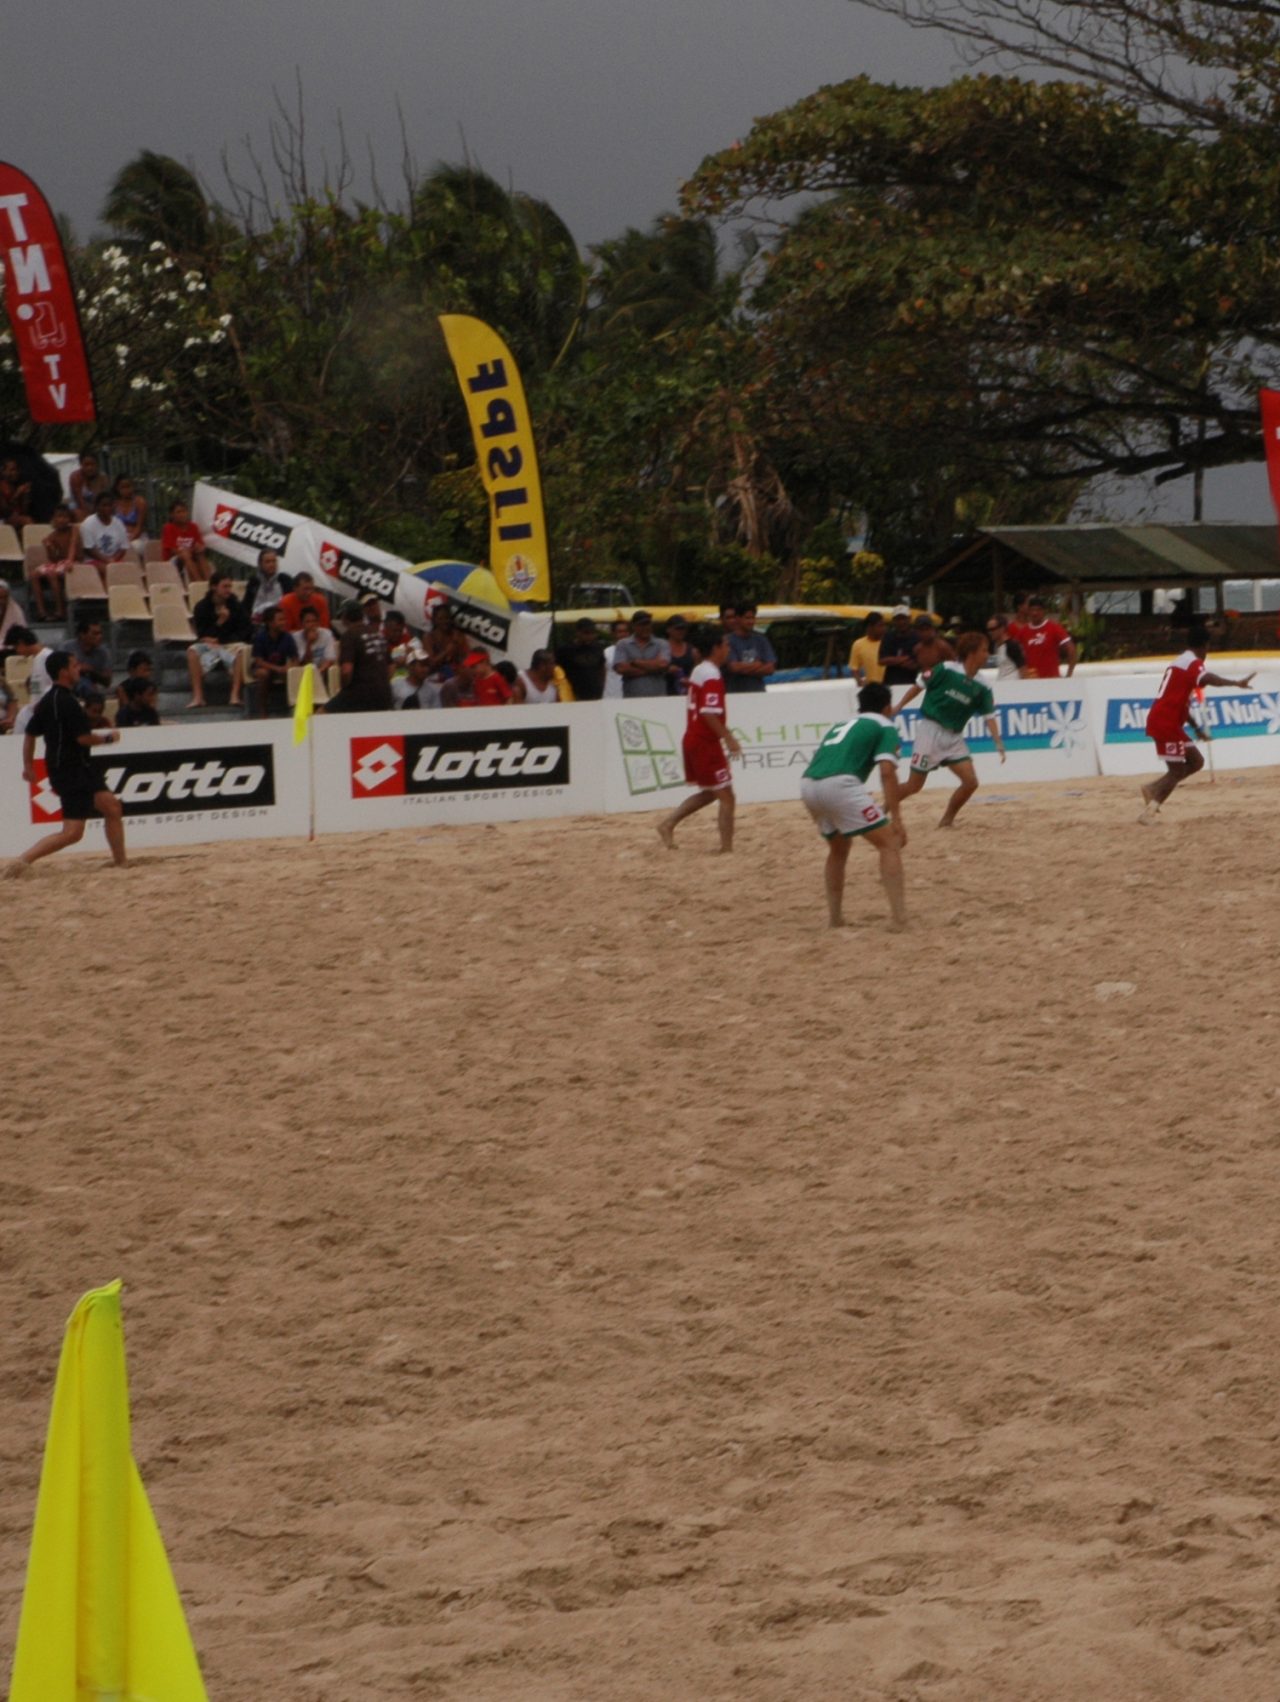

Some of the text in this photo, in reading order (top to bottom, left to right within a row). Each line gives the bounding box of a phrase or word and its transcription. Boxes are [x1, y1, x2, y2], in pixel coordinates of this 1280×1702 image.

[1008, 707, 1049, 736] Nui
[1220, 698, 1263, 725] Nui
[412, 741, 562, 782] lotto
[463, 791, 507, 801] SPORT
[512, 788, 564, 799] DESIGN
[155, 813, 203, 824] SPORT
[211, 809, 268, 820] DESIGN
